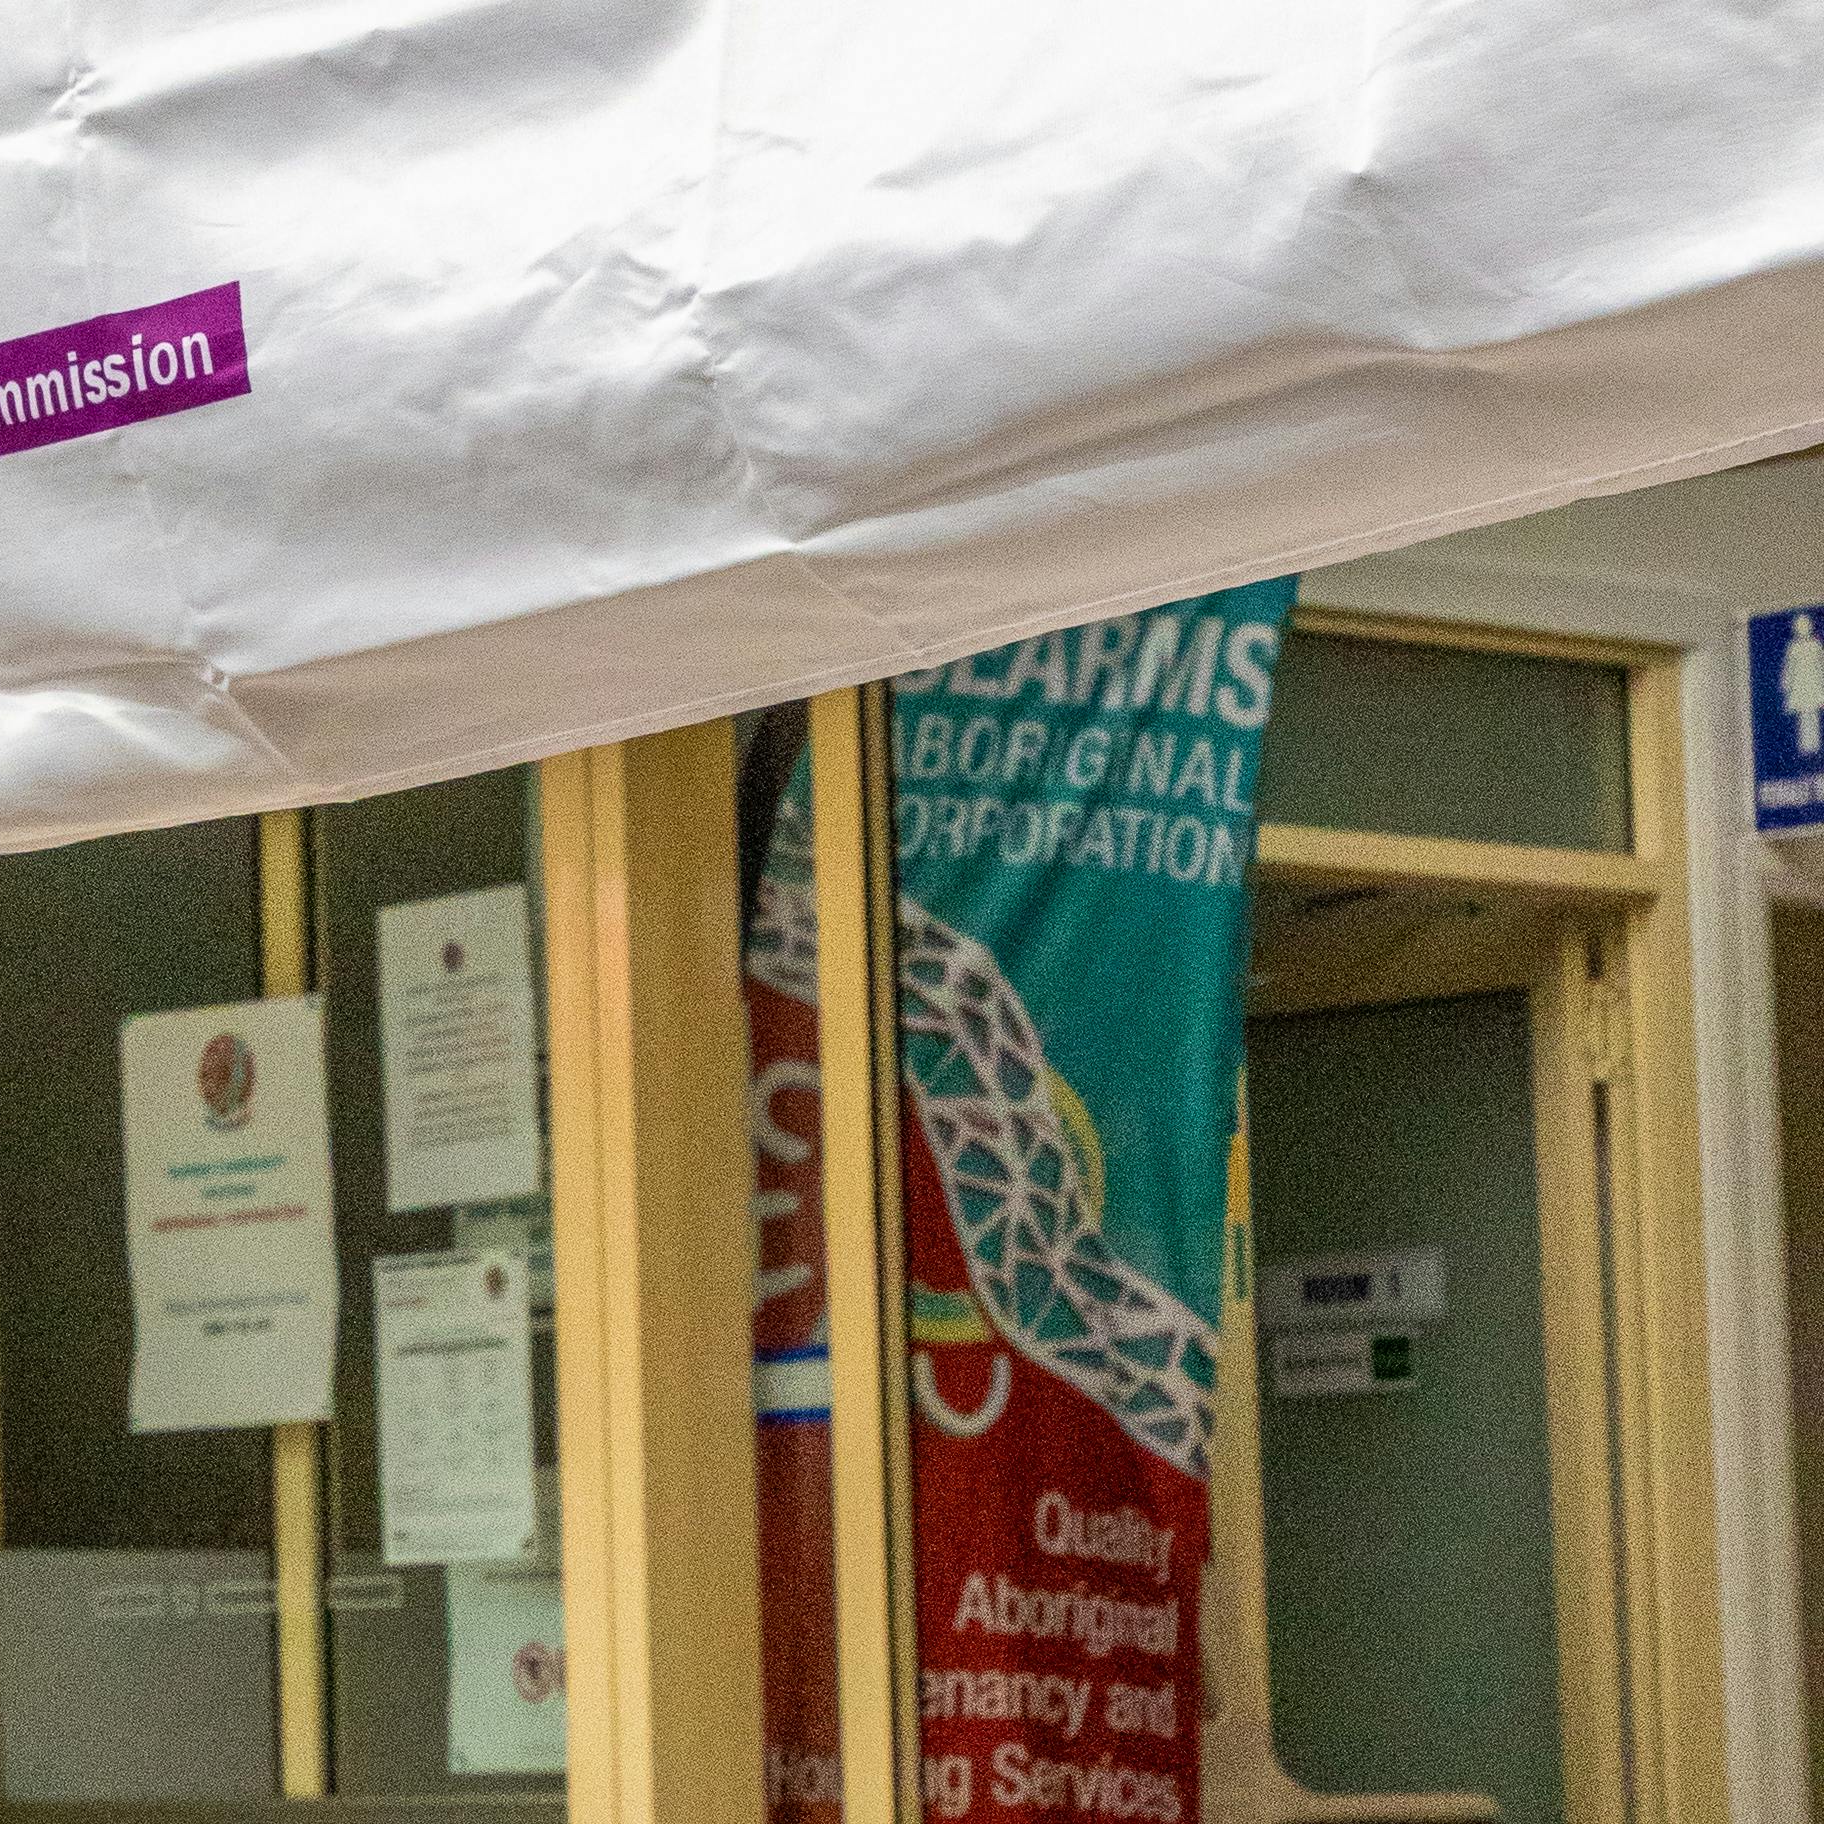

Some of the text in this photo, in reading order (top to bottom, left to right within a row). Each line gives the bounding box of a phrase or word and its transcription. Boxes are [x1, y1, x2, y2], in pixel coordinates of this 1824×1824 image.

[921, 1667, 1177, 1739] enancy and
[991, 1741, 1182, 1822] Services
